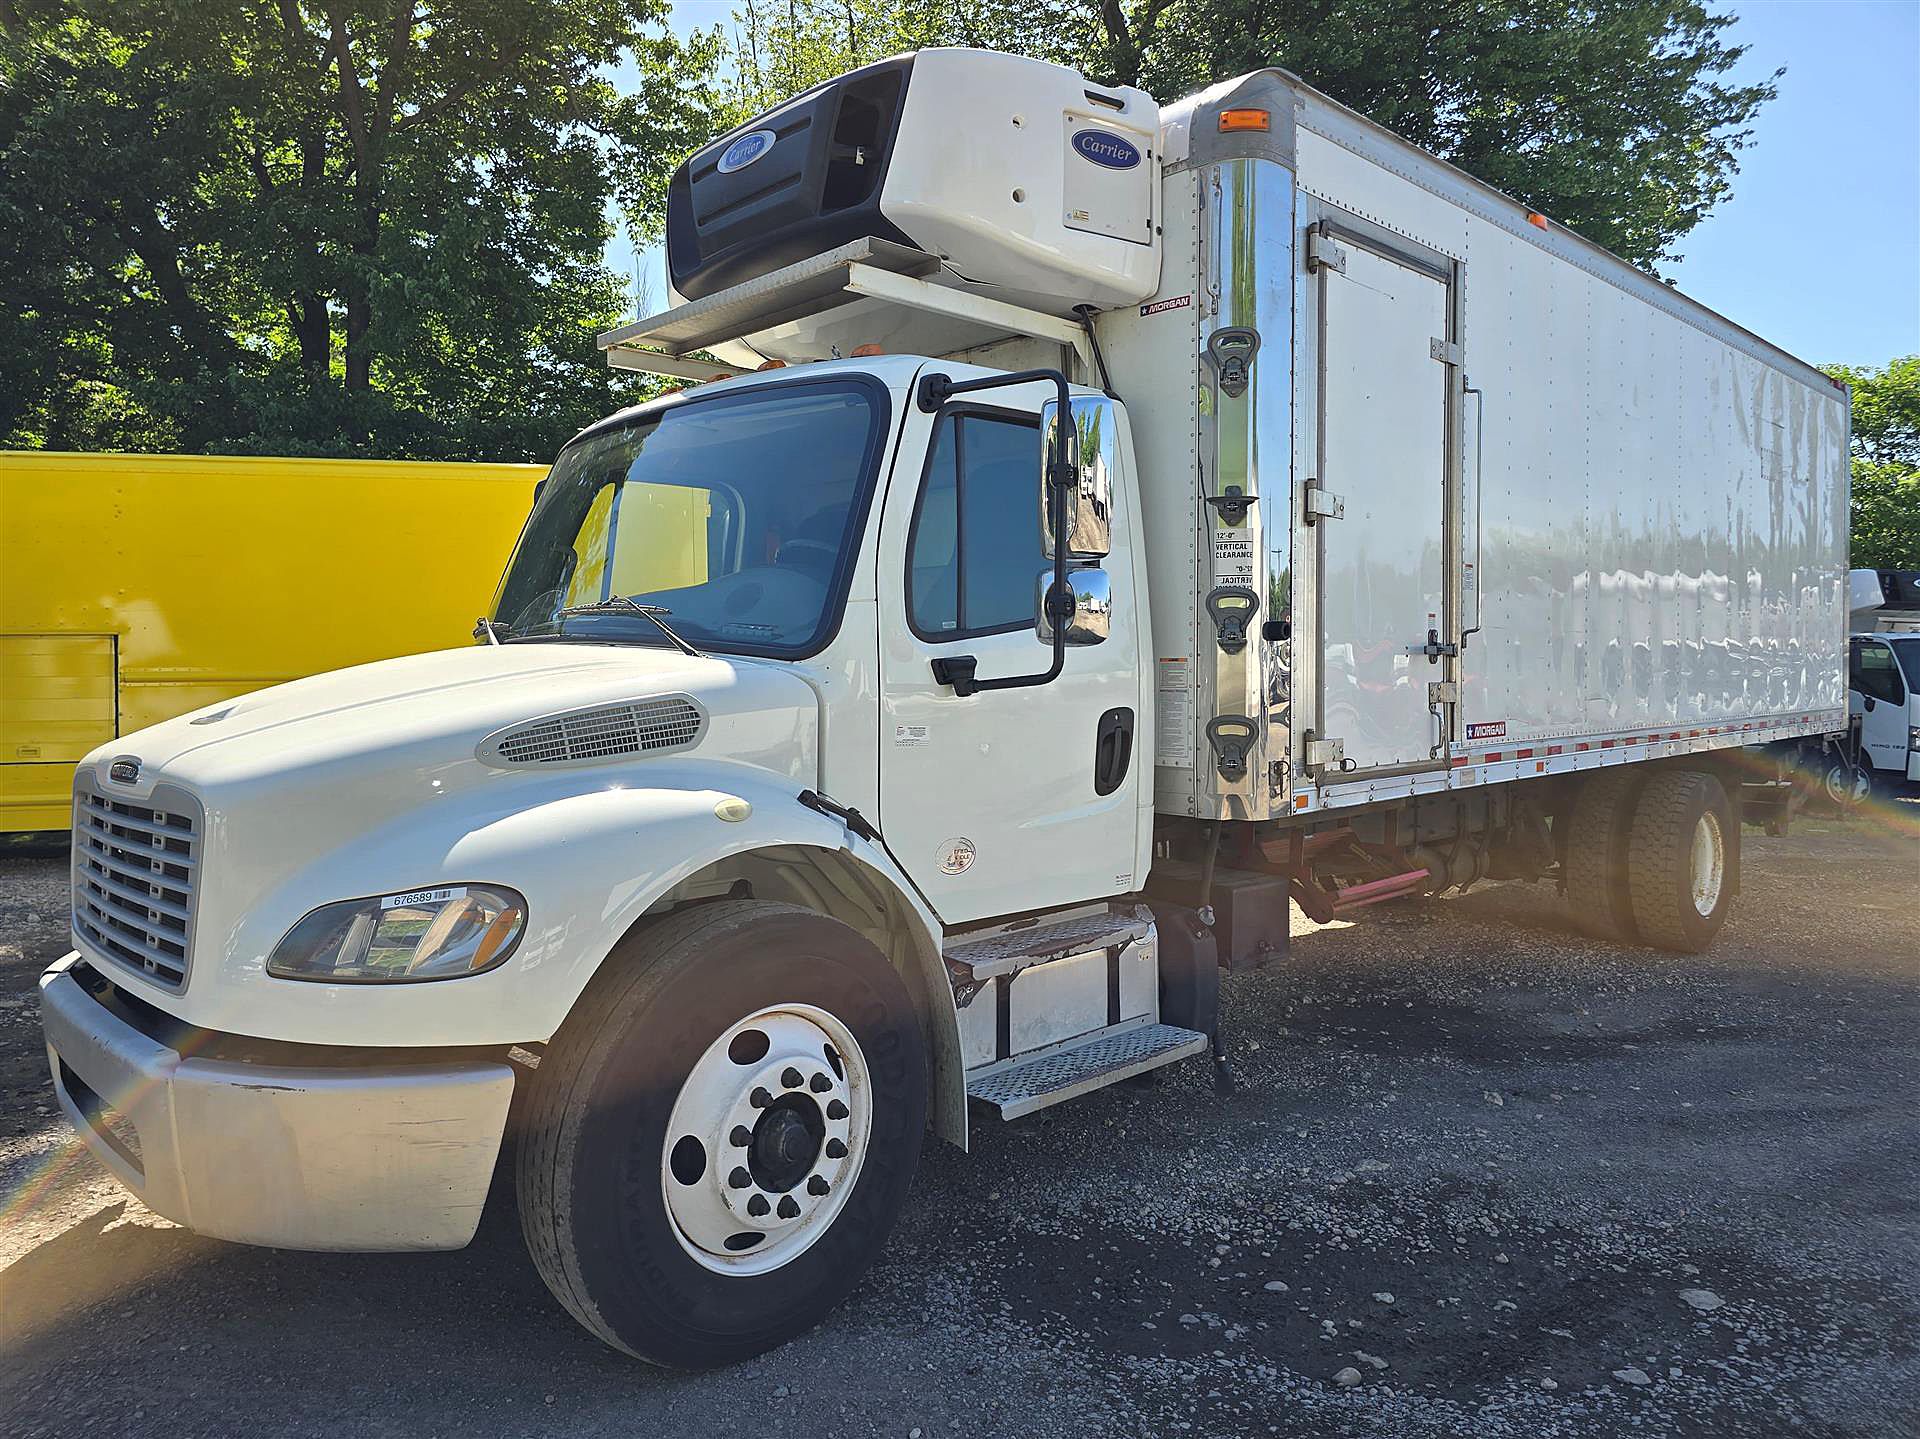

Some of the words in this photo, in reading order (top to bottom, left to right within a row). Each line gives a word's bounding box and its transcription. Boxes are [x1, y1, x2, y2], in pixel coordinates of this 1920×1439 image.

[729, 140, 762, 161] Carrier
[1081, 136, 1133, 161] Carrier
[1149, 297, 1190, 314] MORGAN
[1215, 551, 1253, 559] CLEARANCE
[1474, 724, 1504, 737] MORGAN
[393, 892, 432, 906] 676589
